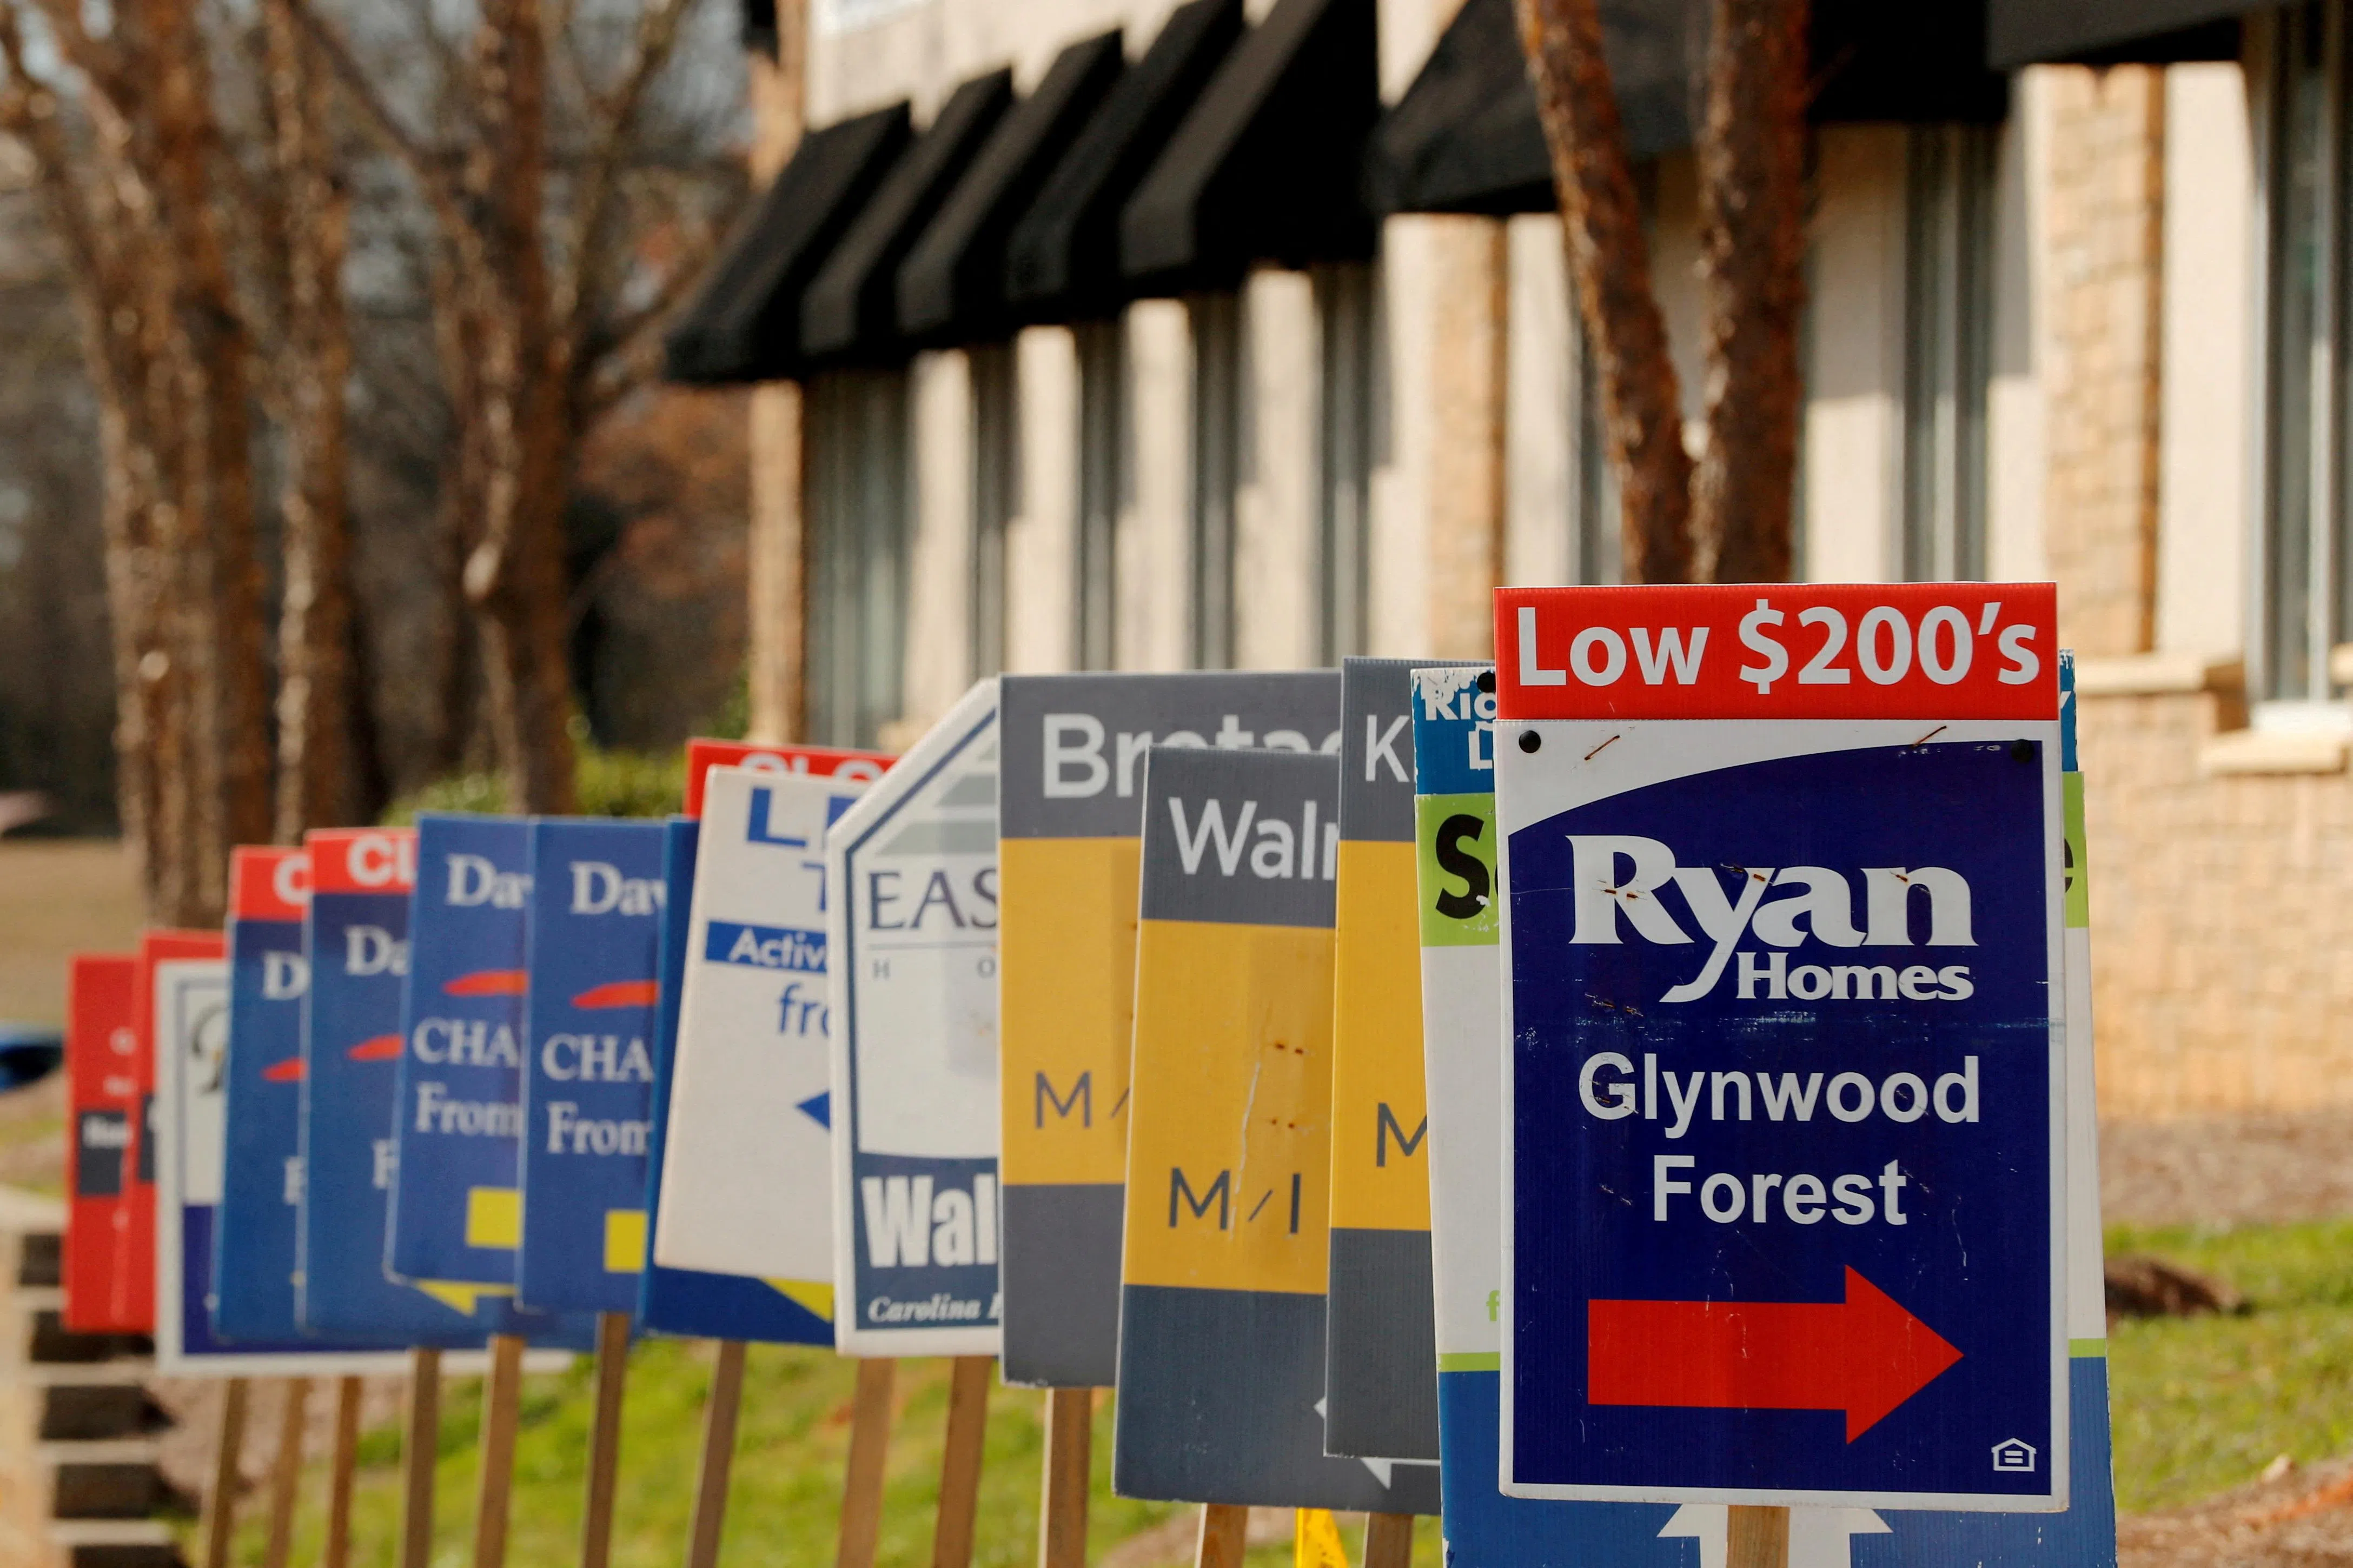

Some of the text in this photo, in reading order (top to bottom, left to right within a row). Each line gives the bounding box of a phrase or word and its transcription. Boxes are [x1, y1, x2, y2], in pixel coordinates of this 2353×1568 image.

[1517, 606, 1710, 687] Low
[1365, 715, 1410, 782] K
[867, 868, 998, 931] EAS
[1435, 814, 1498, 920] S
[1567, 835, 1979, 1004] Ryan
[776, 983, 828, 1037] fr
[1736, 952, 1975, 1001] Homes
[541, 1032, 655, 1082] CHA
[1579, 1052, 1980, 1139] Glynwood
[860, 1172, 998, 1268] Wal
[1653, 1154, 1908, 1226] Forest
[867, 1293, 982, 1324] Carolina
